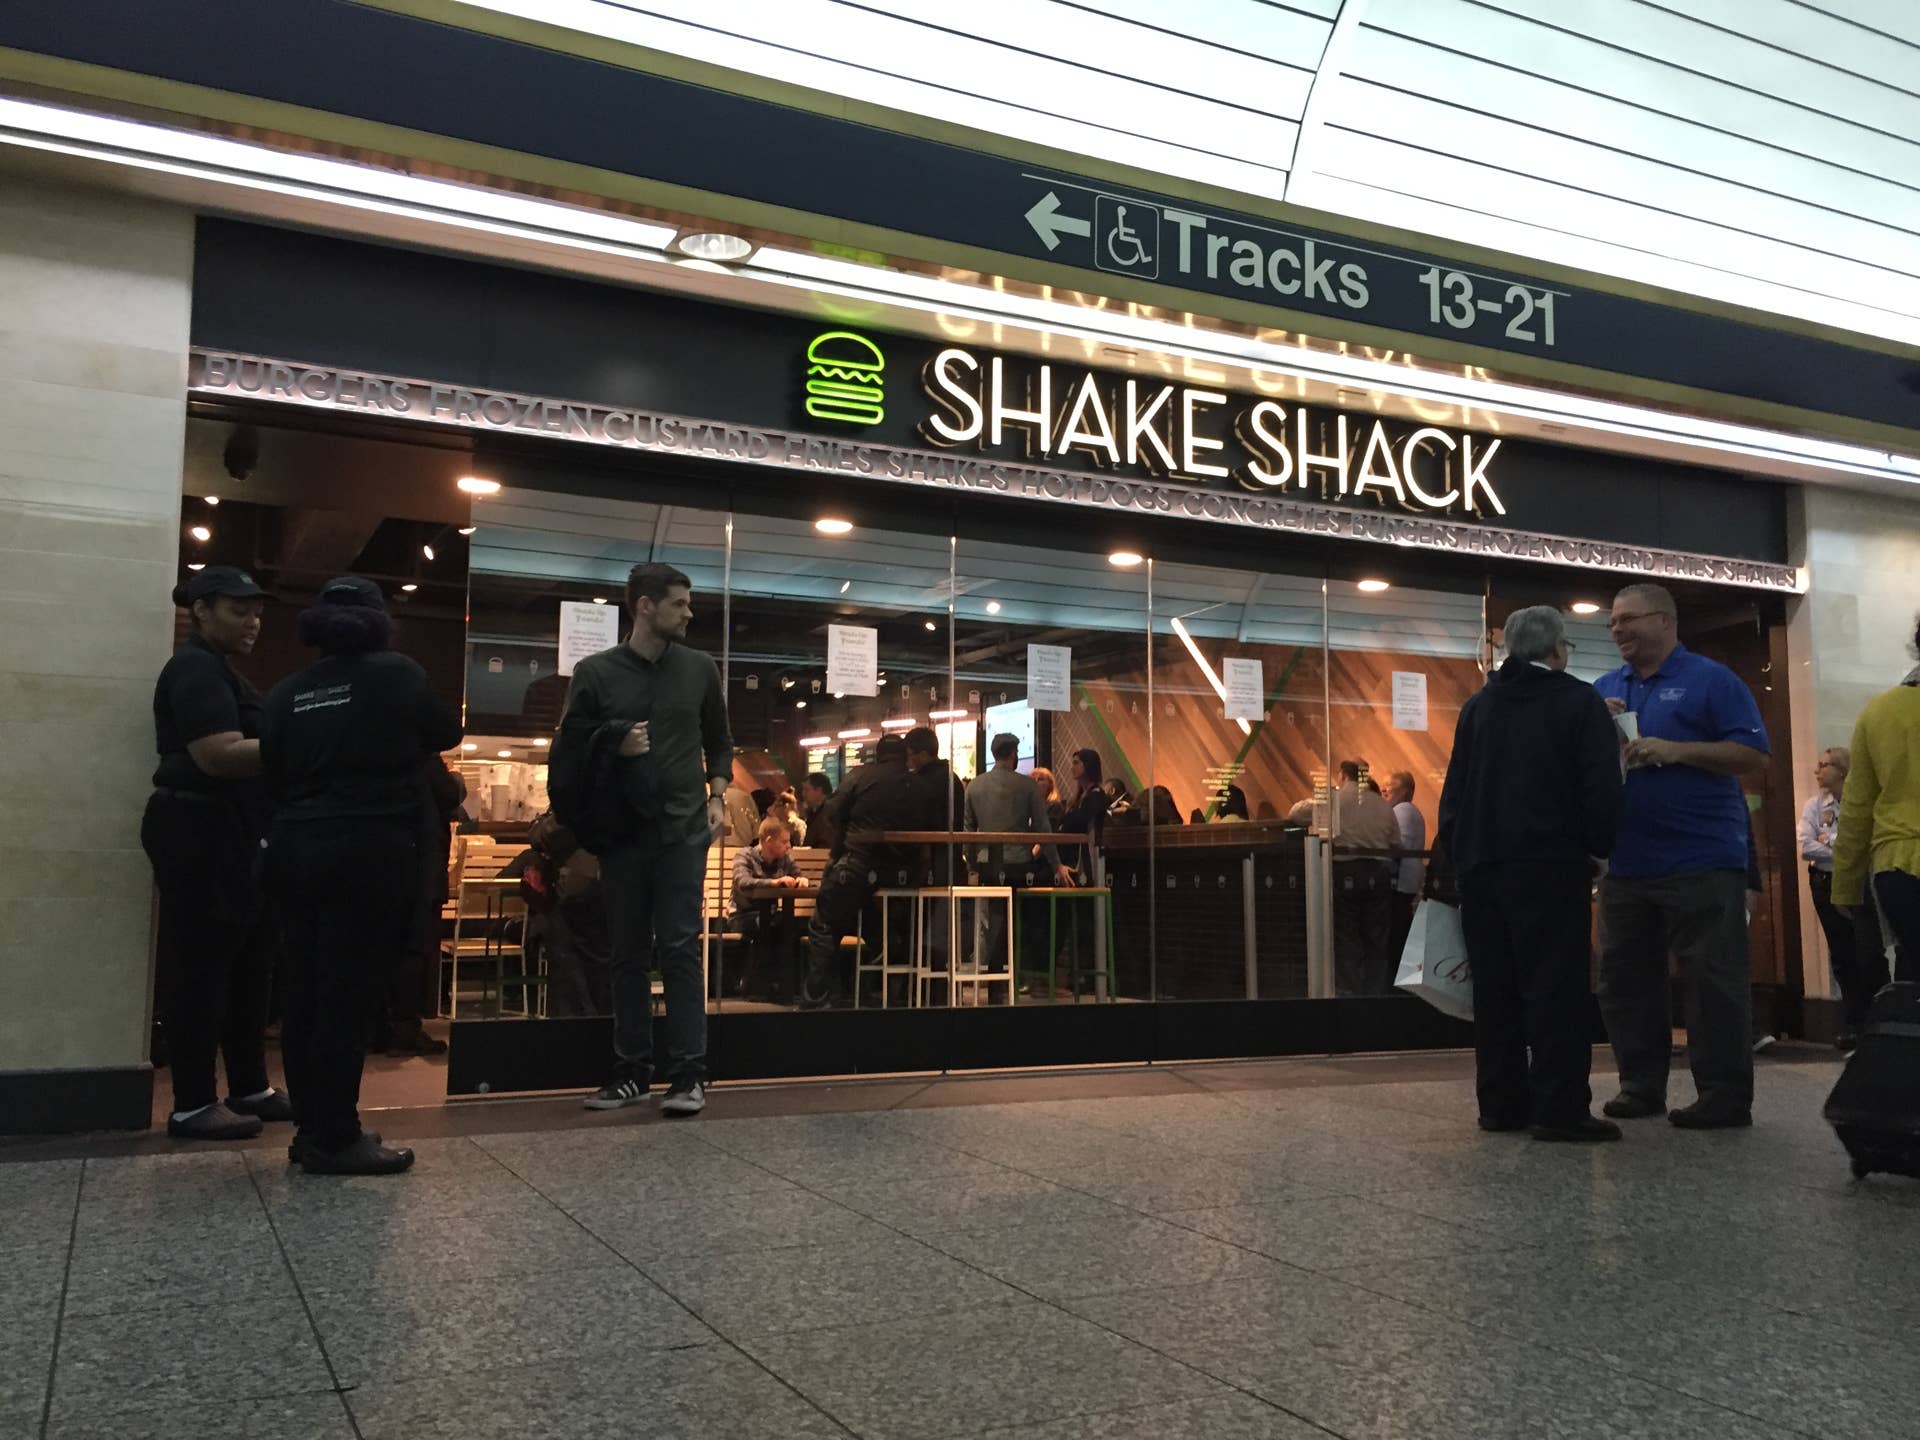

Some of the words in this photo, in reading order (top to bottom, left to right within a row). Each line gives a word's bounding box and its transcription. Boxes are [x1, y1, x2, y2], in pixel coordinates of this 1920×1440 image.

[1164, 208, 1369, 308] Tracks
[1418, 266, 1555, 346] 13-21
[202, 355, 410, 413] BURGERS
[430, 384, 592, 437] FROZEN
[602, 410, 770, 461] CUSTARD
[783, 436, 875, 475] FRIES
[886, 451, 1009, 492] SHAKES
[1021, 468, 1084, 501] HOT
[1089, 478, 1172, 513] DOGS
[1182, 491, 1341, 533] CONCRETES
[1351, 513, 1459, 548] BURGERS
[1466, 528, 1555, 560] FROZEN
[1561, 540, 1655, 572] CUSTARD
[1664, 555, 1715, 580] FRIES
[1723, 561, 1797, 588] SHAKES
[928, 348, 1230, 477] SHAKE
[1247, 401, 1507, 514] SHACK
